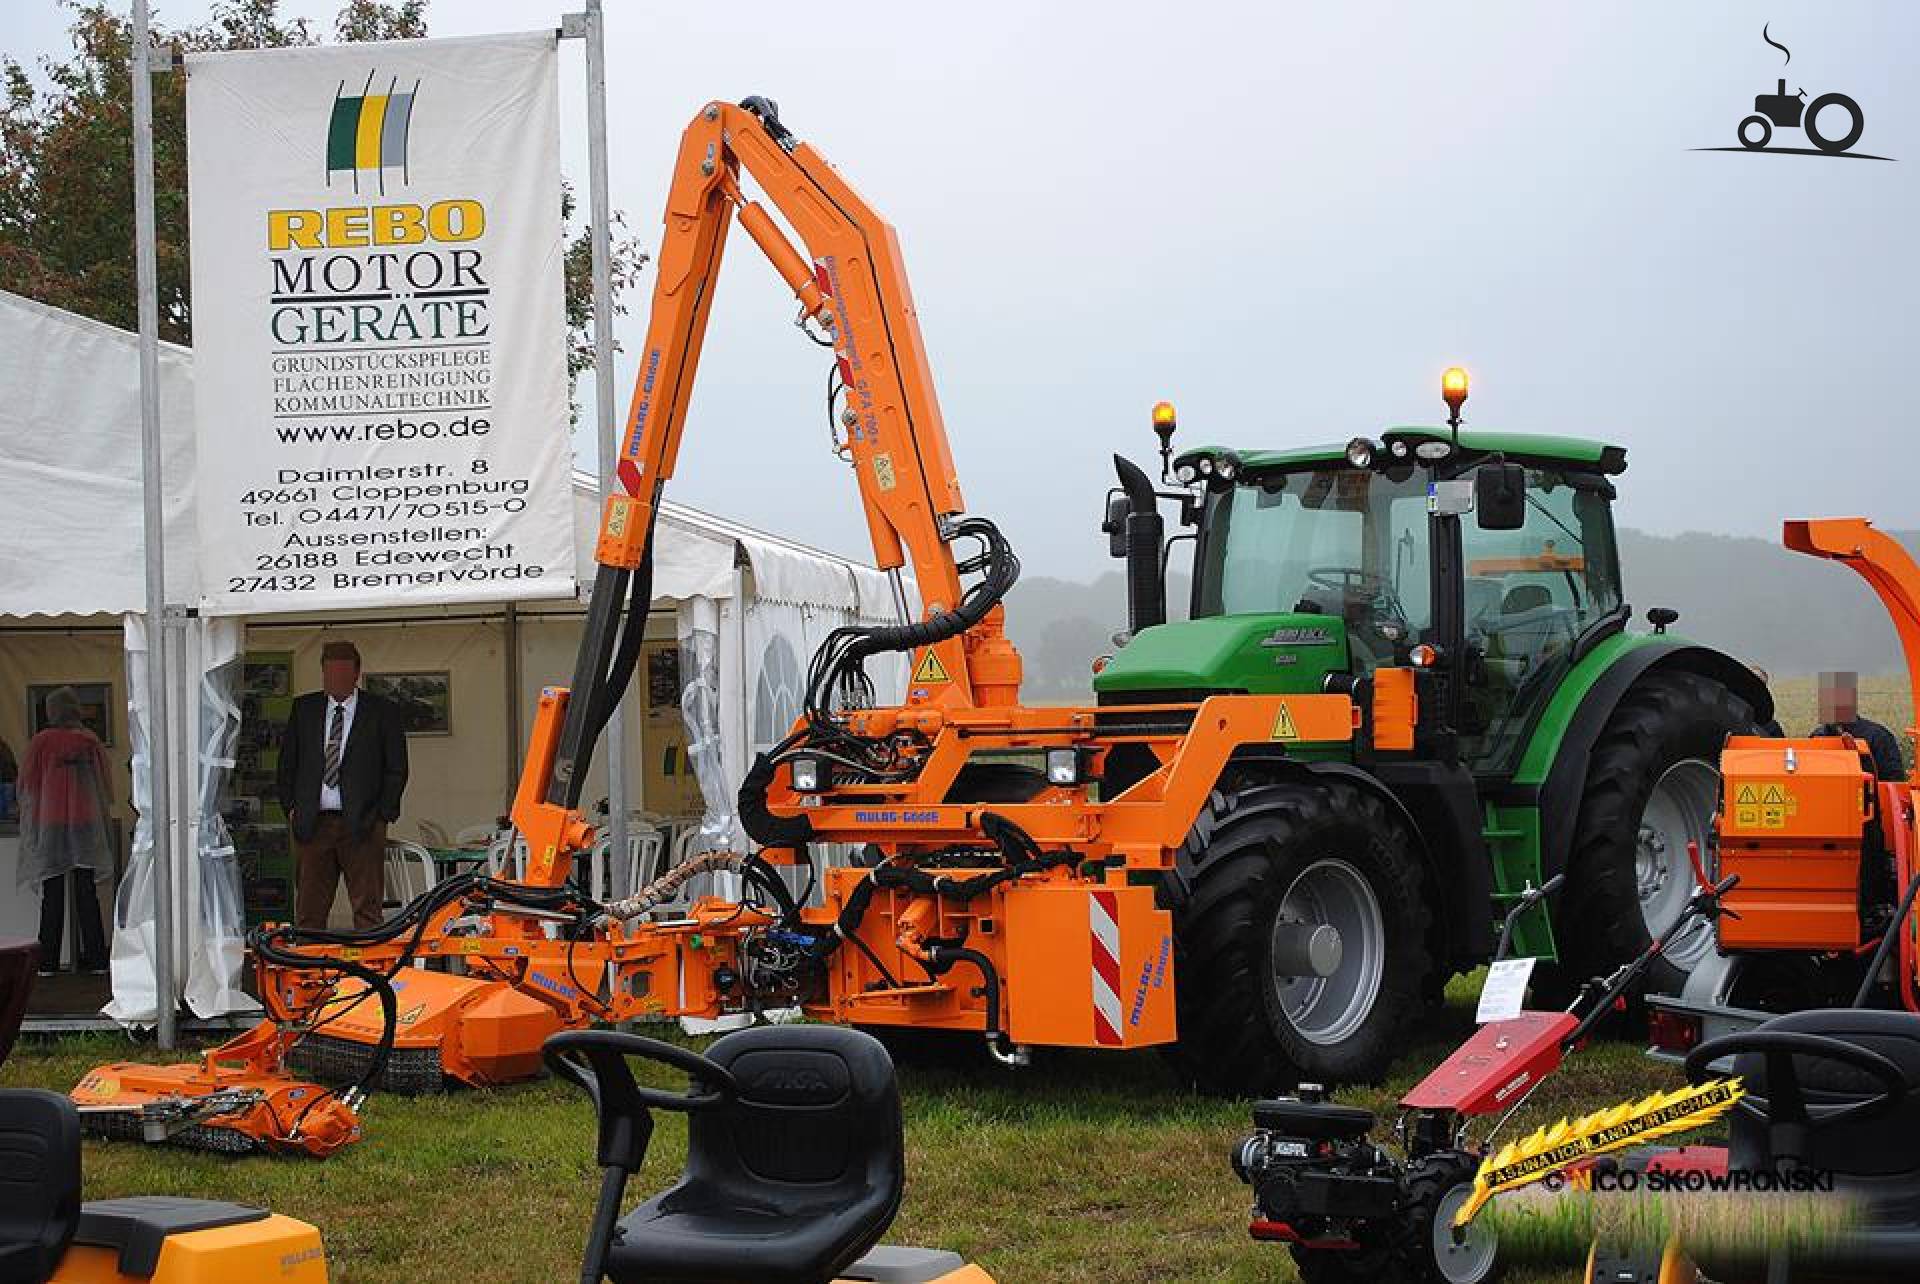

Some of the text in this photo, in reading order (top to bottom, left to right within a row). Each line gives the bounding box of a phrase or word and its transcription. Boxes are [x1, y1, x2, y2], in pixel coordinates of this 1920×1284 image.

[267, 200, 486, 251] REBO
[272, 250, 486, 295] MOTOR
[271, 293, 489, 345] GERÄTE
[273, 348, 491, 374] GRUNDSTÜCKSPFLEGE
[274, 369, 491, 394] FLÄCHENREINIGUNG
[275, 389, 490, 414] KOMMUNALTECHNIK
[276, 416, 491, 443] www.rebo.de
[278, 459, 489, 485] Daimlerstr. 8
[240, 478, 529, 506] 49661 Cloppenburg
[244, 510, 285, 527] Tel.
[284, 526, 488, 549] Aussenstellen:
[256, 542, 516, 571] 26188 Edewecht
[229, 563, 545, 593] 27432 Bremervörde
